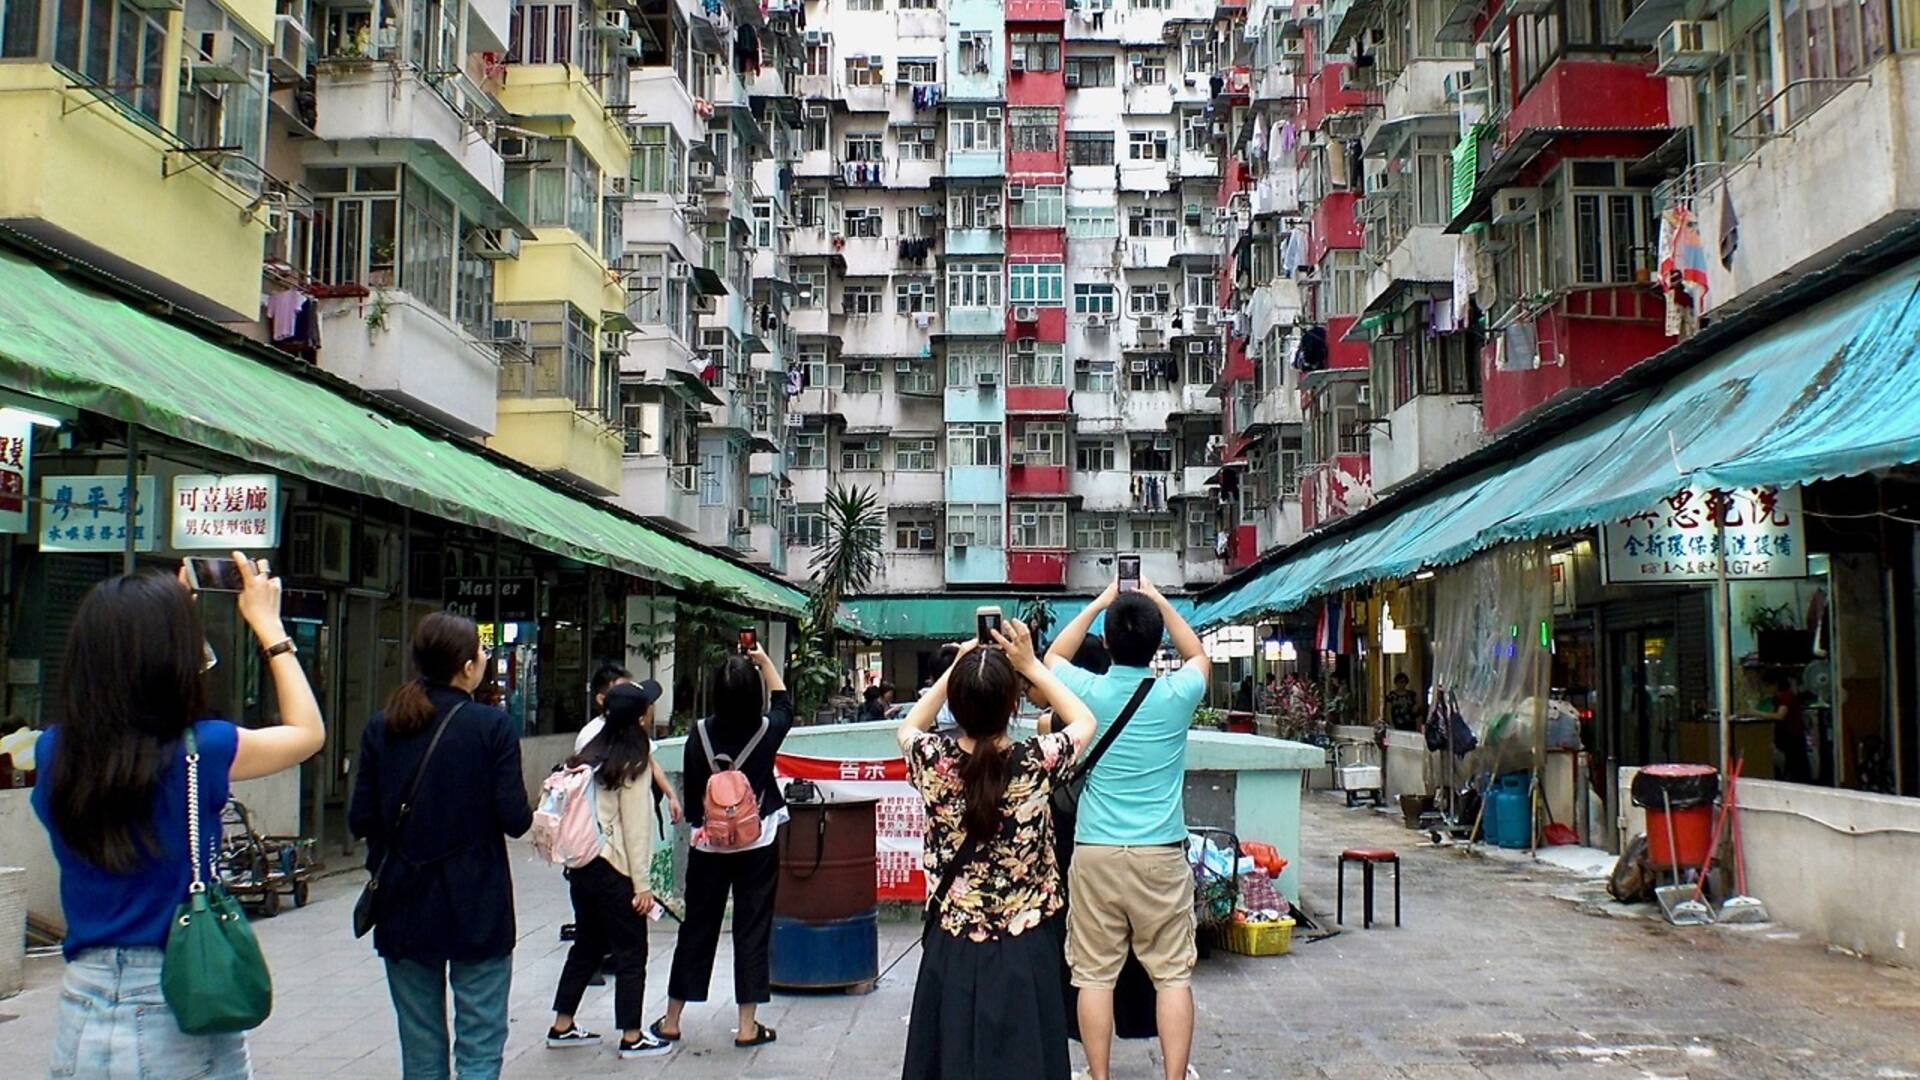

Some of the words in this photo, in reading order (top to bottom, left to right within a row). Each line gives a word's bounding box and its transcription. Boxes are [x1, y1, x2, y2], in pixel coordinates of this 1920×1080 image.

[178, 486, 268, 513] 可喜髮廊
[457, 580, 521, 596] Maser
[839, 761, 886, 780] 告示
